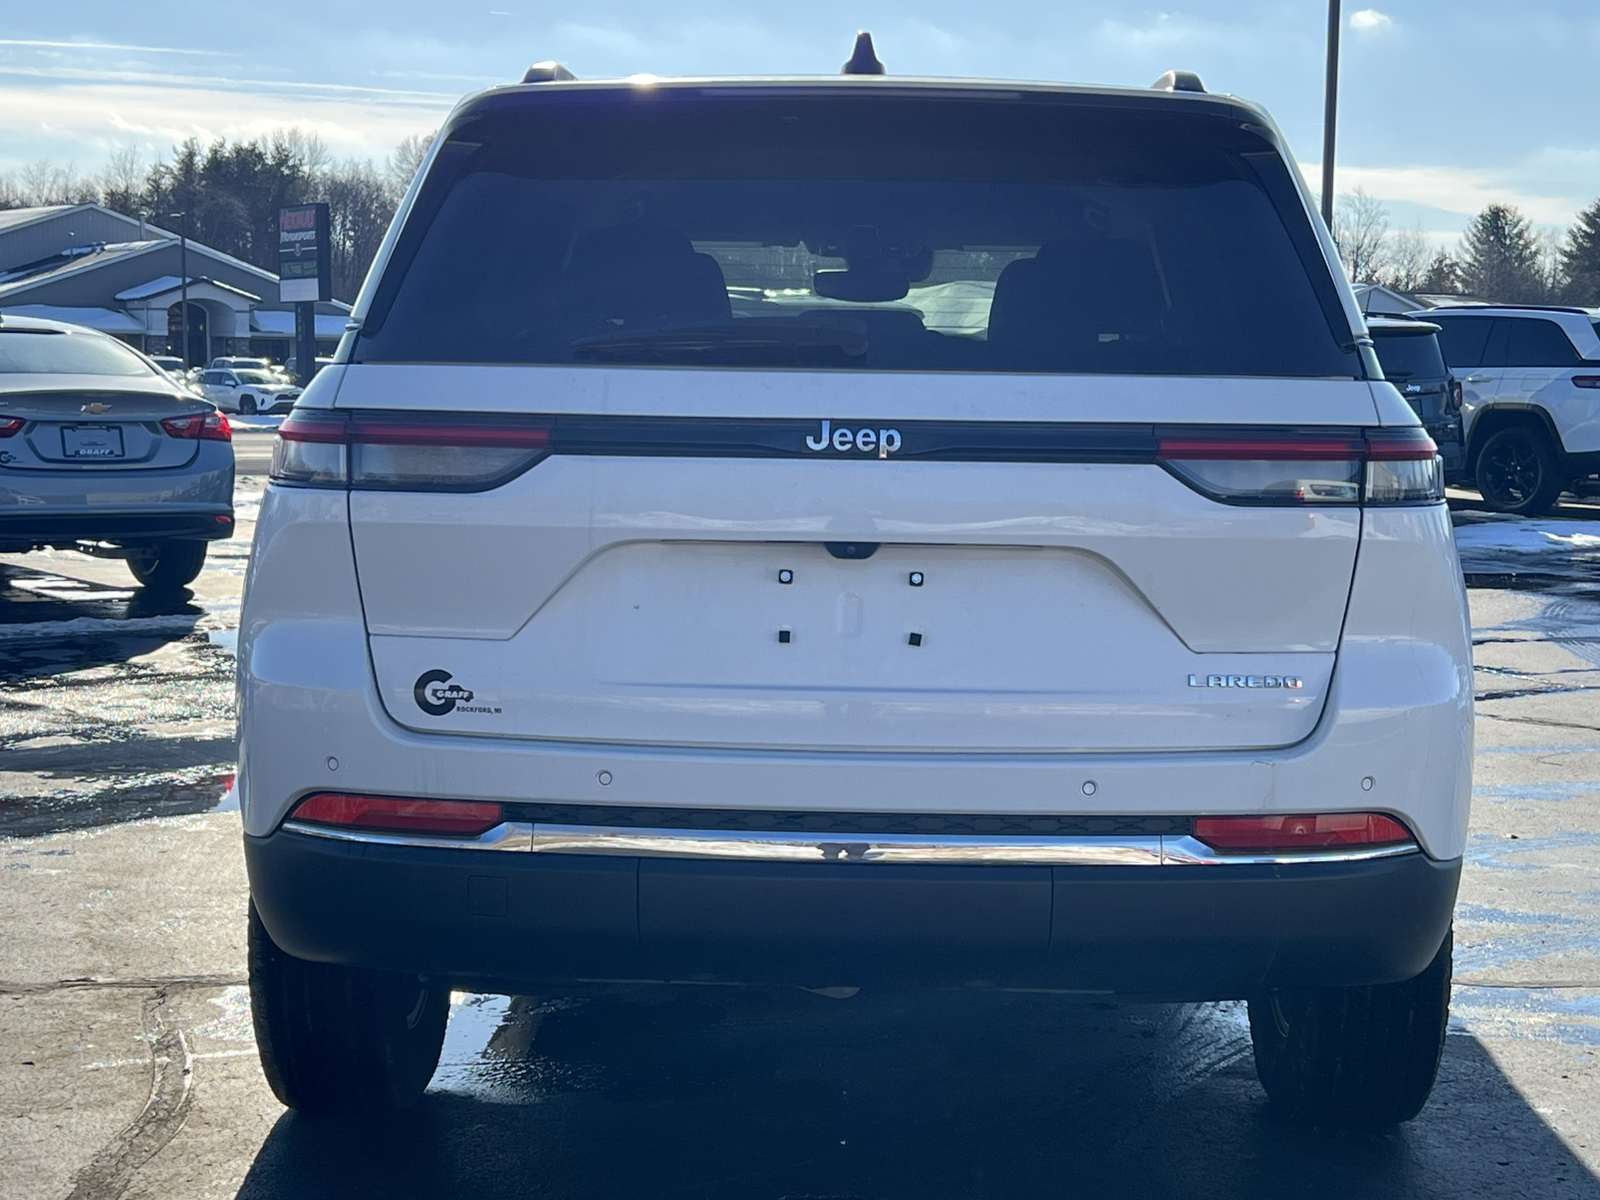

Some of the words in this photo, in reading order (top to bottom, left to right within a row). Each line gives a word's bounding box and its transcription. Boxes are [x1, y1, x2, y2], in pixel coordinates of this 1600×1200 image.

[1406, 384, 1420, 392] Jeep
[806, 420, 902, 459] Jeep
[1187, 674, 1303, 689] LAREDO
[436, 690, 470, 698] GRAFF
[456, 706, 493, 714] ROCKFORD,
